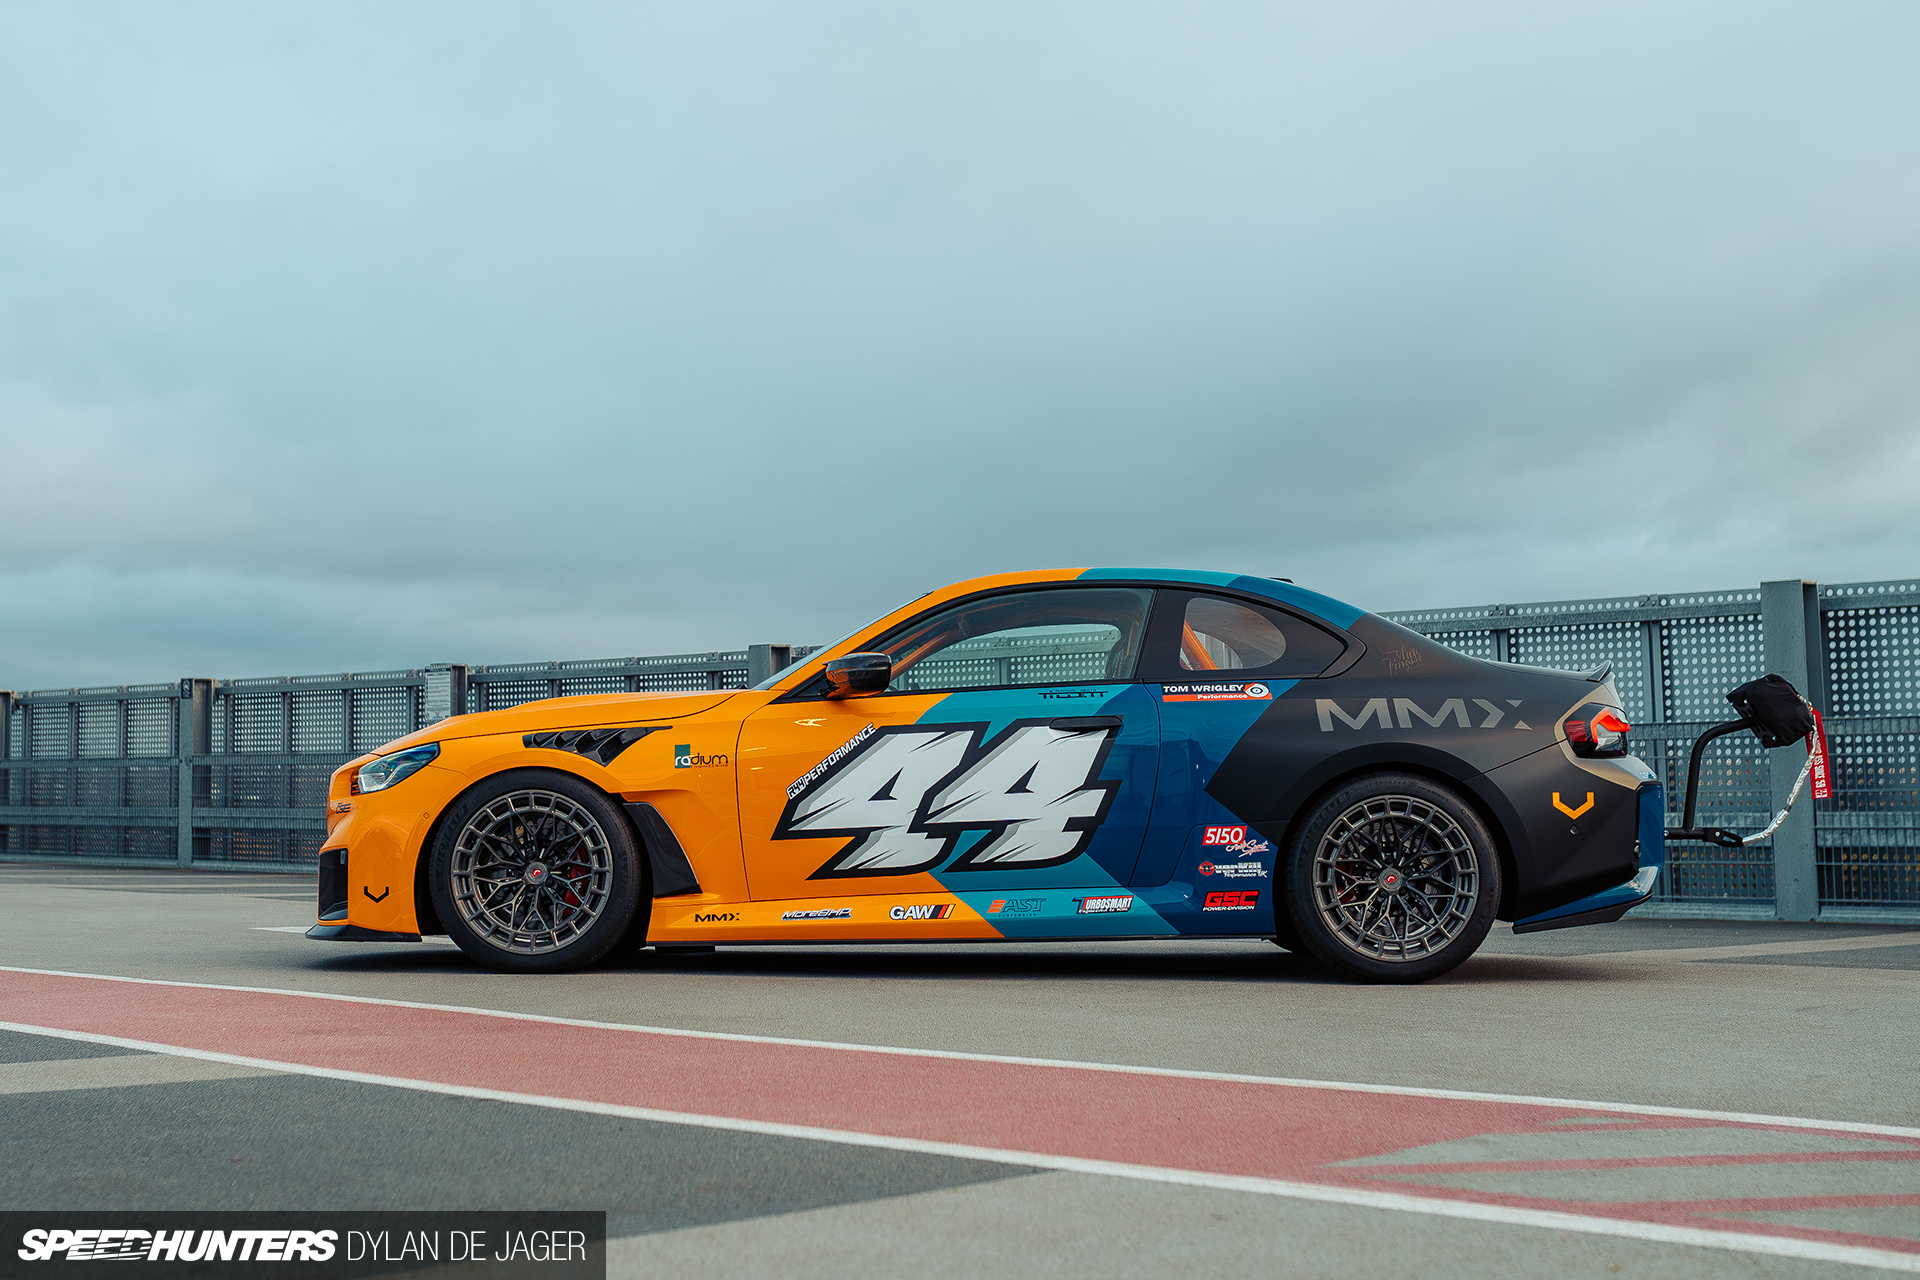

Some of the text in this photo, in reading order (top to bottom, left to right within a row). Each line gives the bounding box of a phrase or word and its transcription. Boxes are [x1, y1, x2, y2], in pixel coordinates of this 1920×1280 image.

[1163, 684, 1244, 693] TOM WRIGLEY
[1315, 698, 1534, 732] MMX
[675, 753, 728, 766] radium
[786, 722, 876, 799] R44 PERFORMANCE
[774, 717, 1120, 877] 44
[436, 806, 465, 873] MICHELIN
[1205, 827, 1243, 844] 5150
[1072, 896, 1134, 911] TURBOSMART
[1204, 891, 1259, 907] GSC
[695, 912, 740, 923] MMX
[889, 905, 935, 920] GAW
